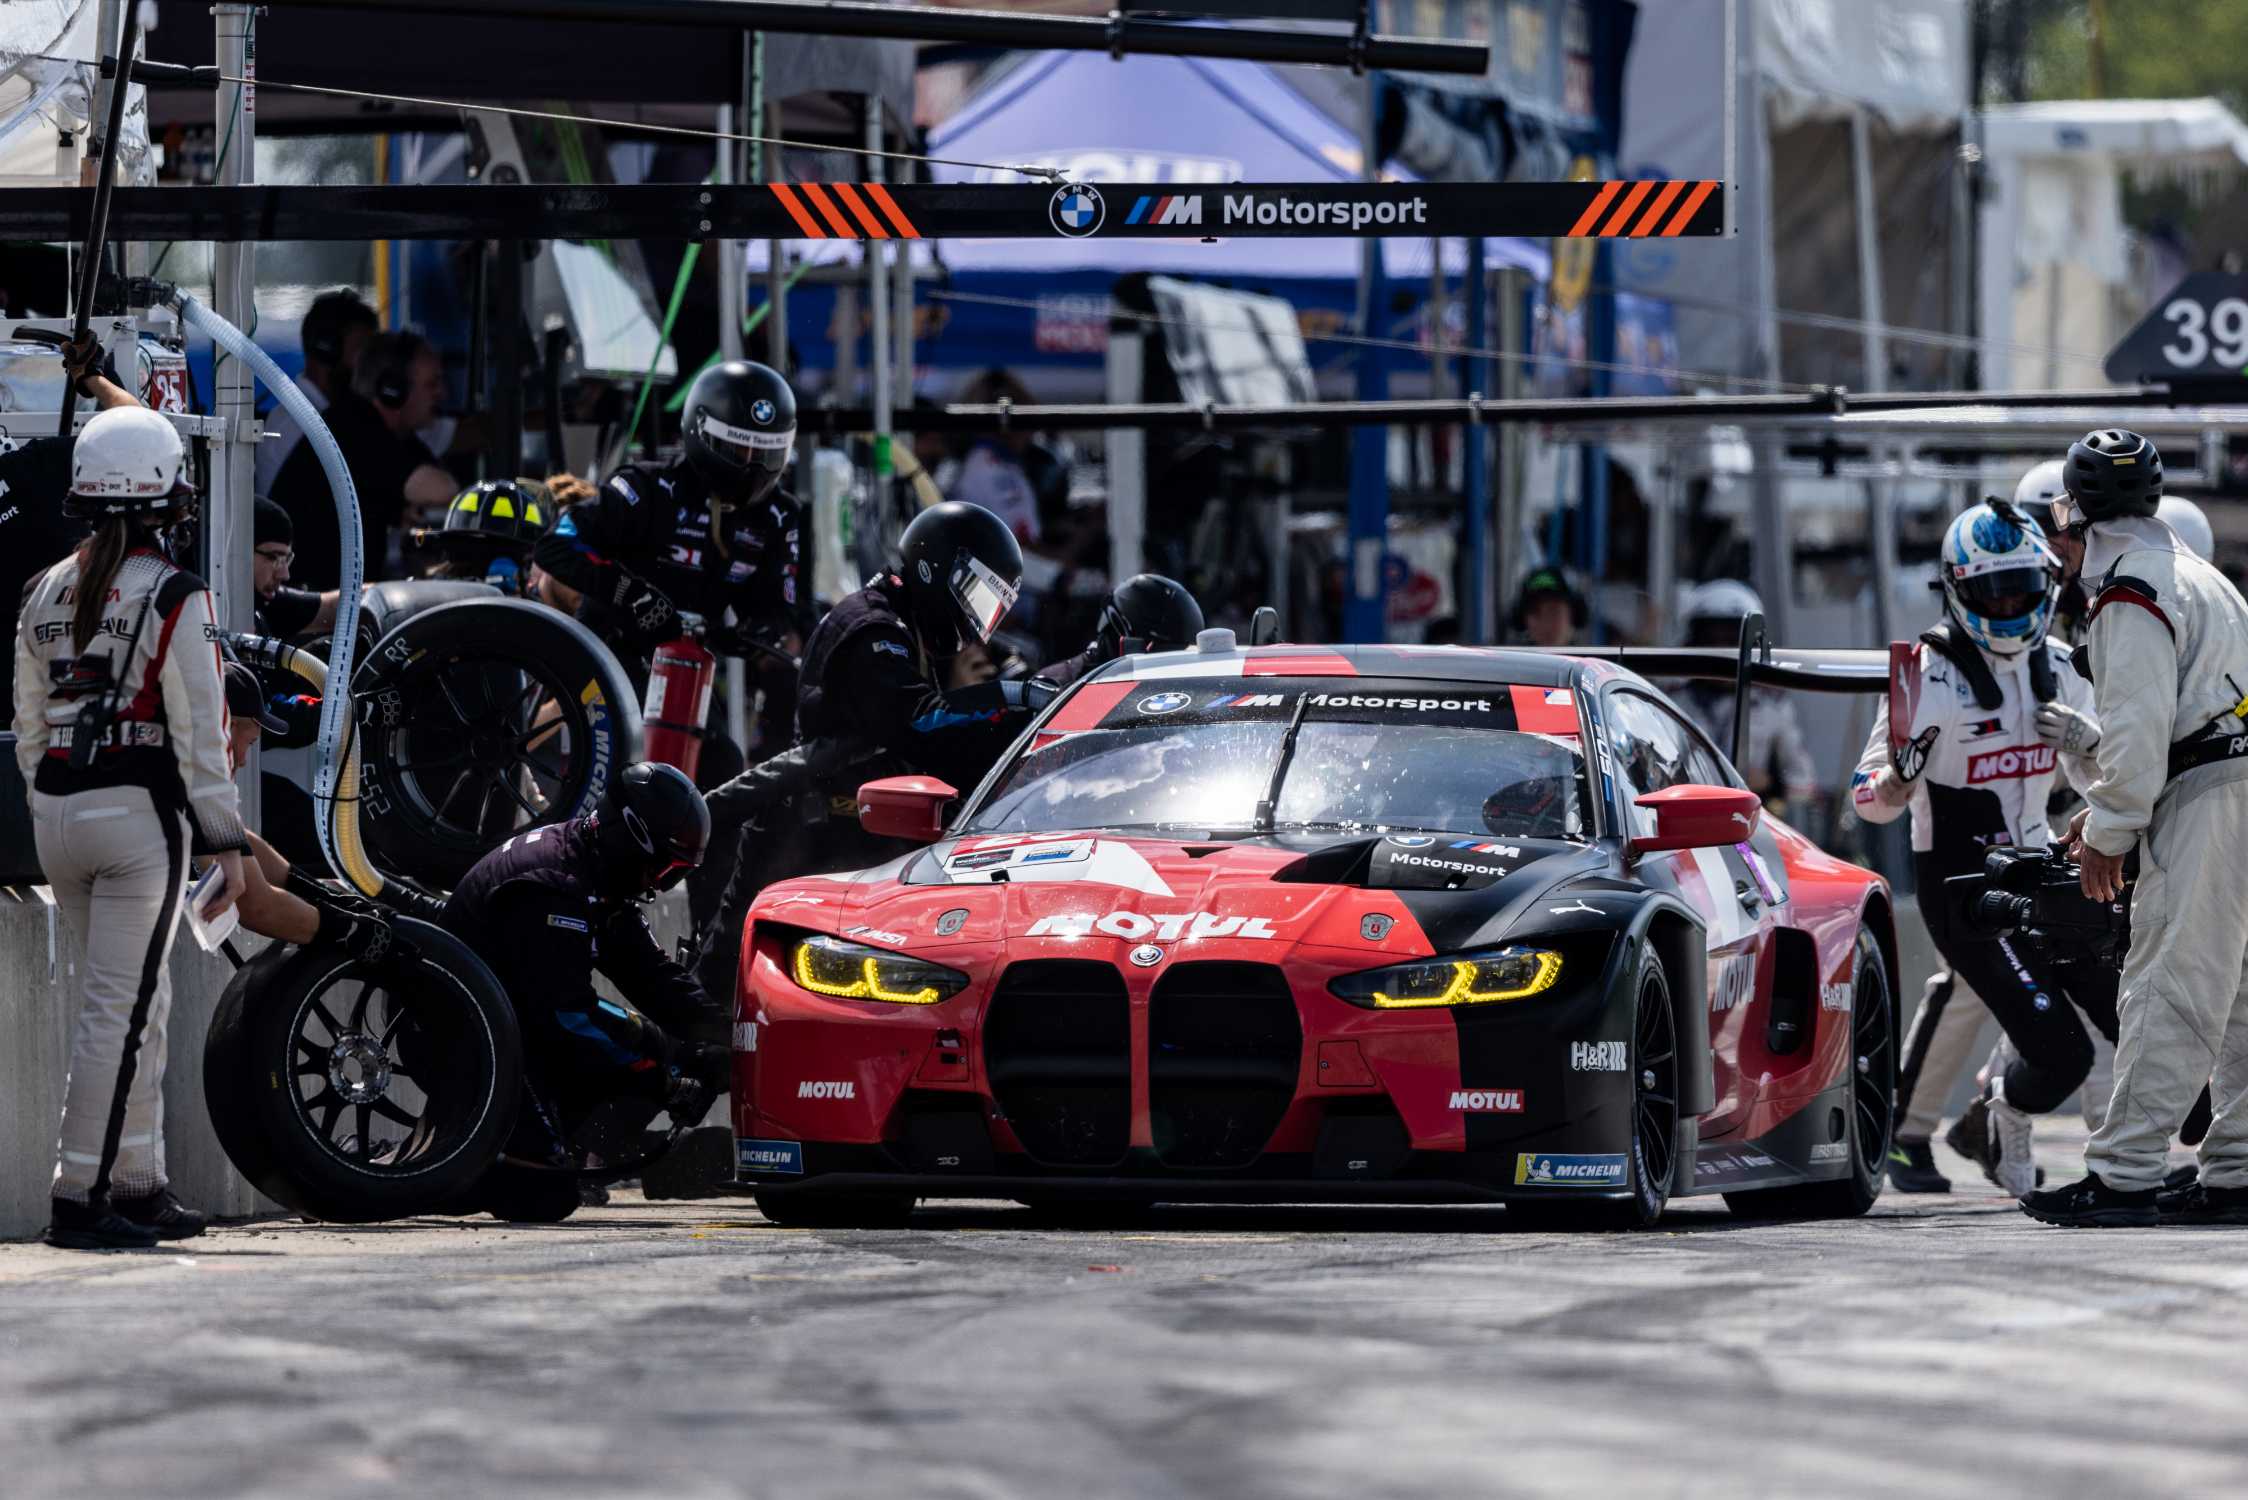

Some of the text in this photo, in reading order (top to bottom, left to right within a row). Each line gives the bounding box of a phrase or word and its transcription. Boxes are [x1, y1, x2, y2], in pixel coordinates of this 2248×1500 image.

[1158, 195, 1428, 231] M Motorsport
[2162, 298, 2248, 368] 39
[384, 637, 412, 663] RR
[1236, 694, 1491, 712] M Motorsport
[574, 729, 610, 819] MICHEL
[1480, 844, 1520, 859] M
[1389, 852, 1507, 877] Motorsport
[1025, 910, 1278, 941] MOTUL
[1712, 953, 1756, 1012] MOTUL
[1571, 1041, 1613, 1071] H&R
[798, 1081, 856, 1099] MOTUL
[1448, 1092, 1521, 1110] MOTUL
[740, 1149, 792, 1164] MICHELIN
[1554, 1164, 1622, 1177] MICHELIN
